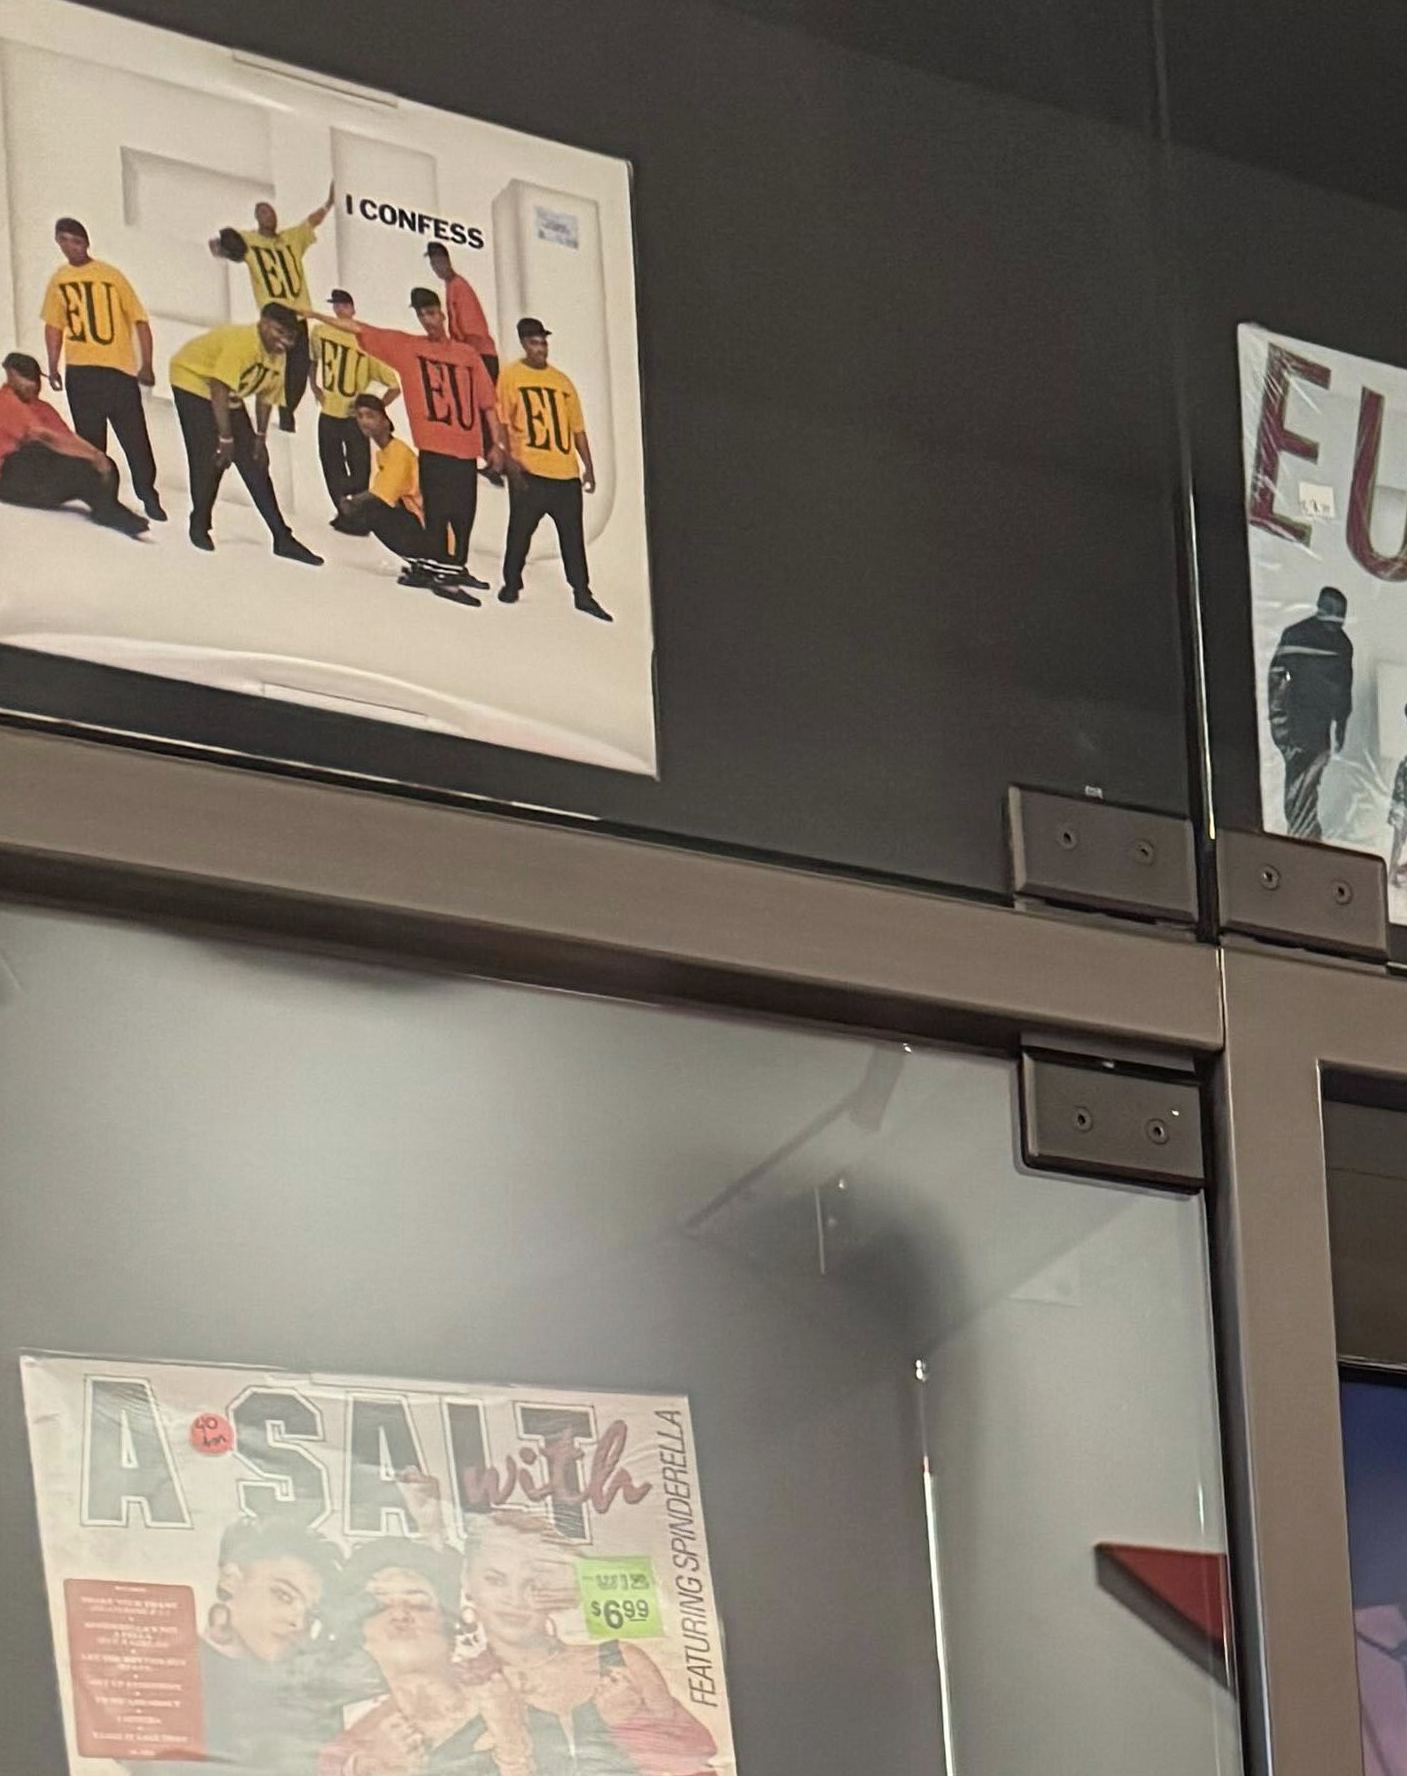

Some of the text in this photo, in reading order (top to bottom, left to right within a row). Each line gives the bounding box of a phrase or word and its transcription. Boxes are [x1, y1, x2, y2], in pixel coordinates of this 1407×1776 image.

[344, 193, 486, 251] I CONFESS
[253, 243, 305, 300] EU
[59, 281, 118, 347] EU
[319, 337, 369, 398] EU
[416, 354, 476, 431] EU
[518, 385, 573, 452] EU
[81, 1374, 653, 1553] A SALT with
[659, 1409, 718, 1710] FEATURING SPINDERELLA
